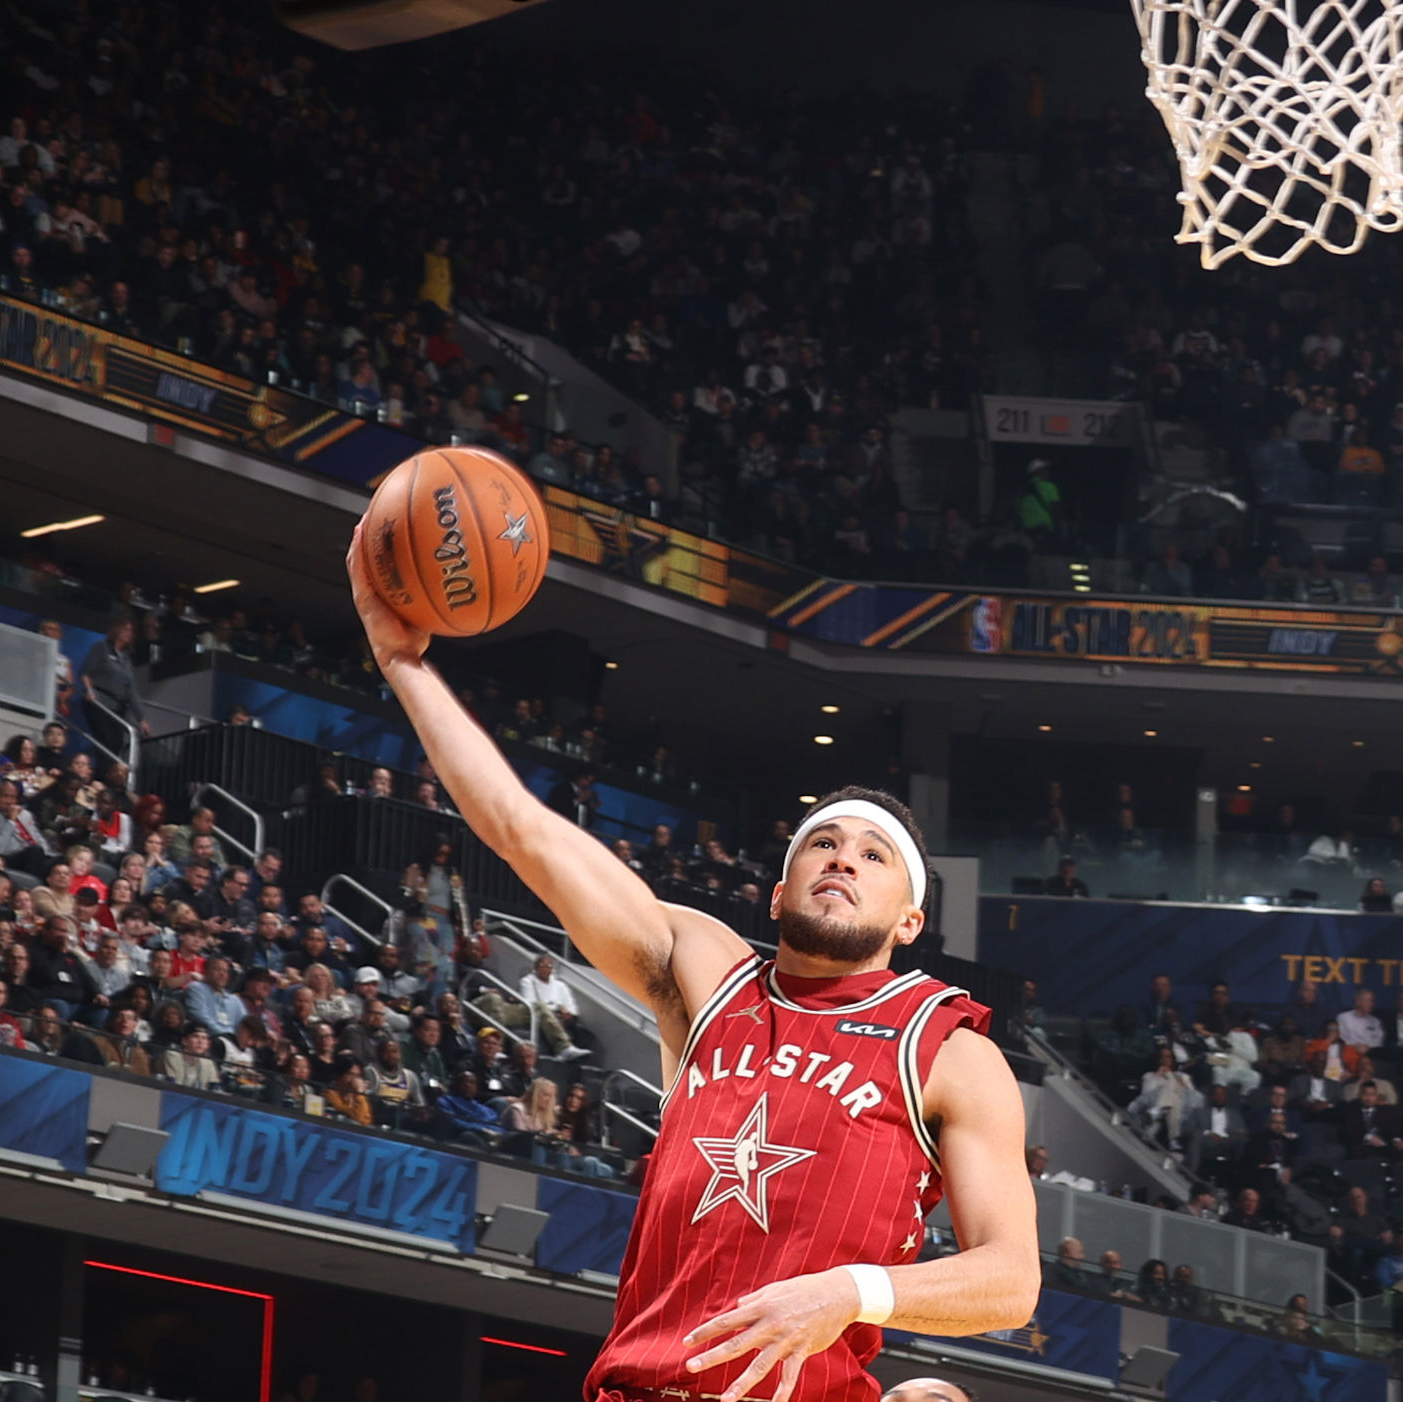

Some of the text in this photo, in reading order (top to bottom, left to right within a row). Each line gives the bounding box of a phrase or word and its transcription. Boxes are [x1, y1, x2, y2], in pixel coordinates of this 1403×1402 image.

[997, 408, 1029, 433] 211
[434, 484, 479, 611] Wilson
[1281, 954, 1370, 984] TEXT
[688, 1043, 883, 1119] ALL-STAR
[168, 1108, 469, 1238] INDY 2024
